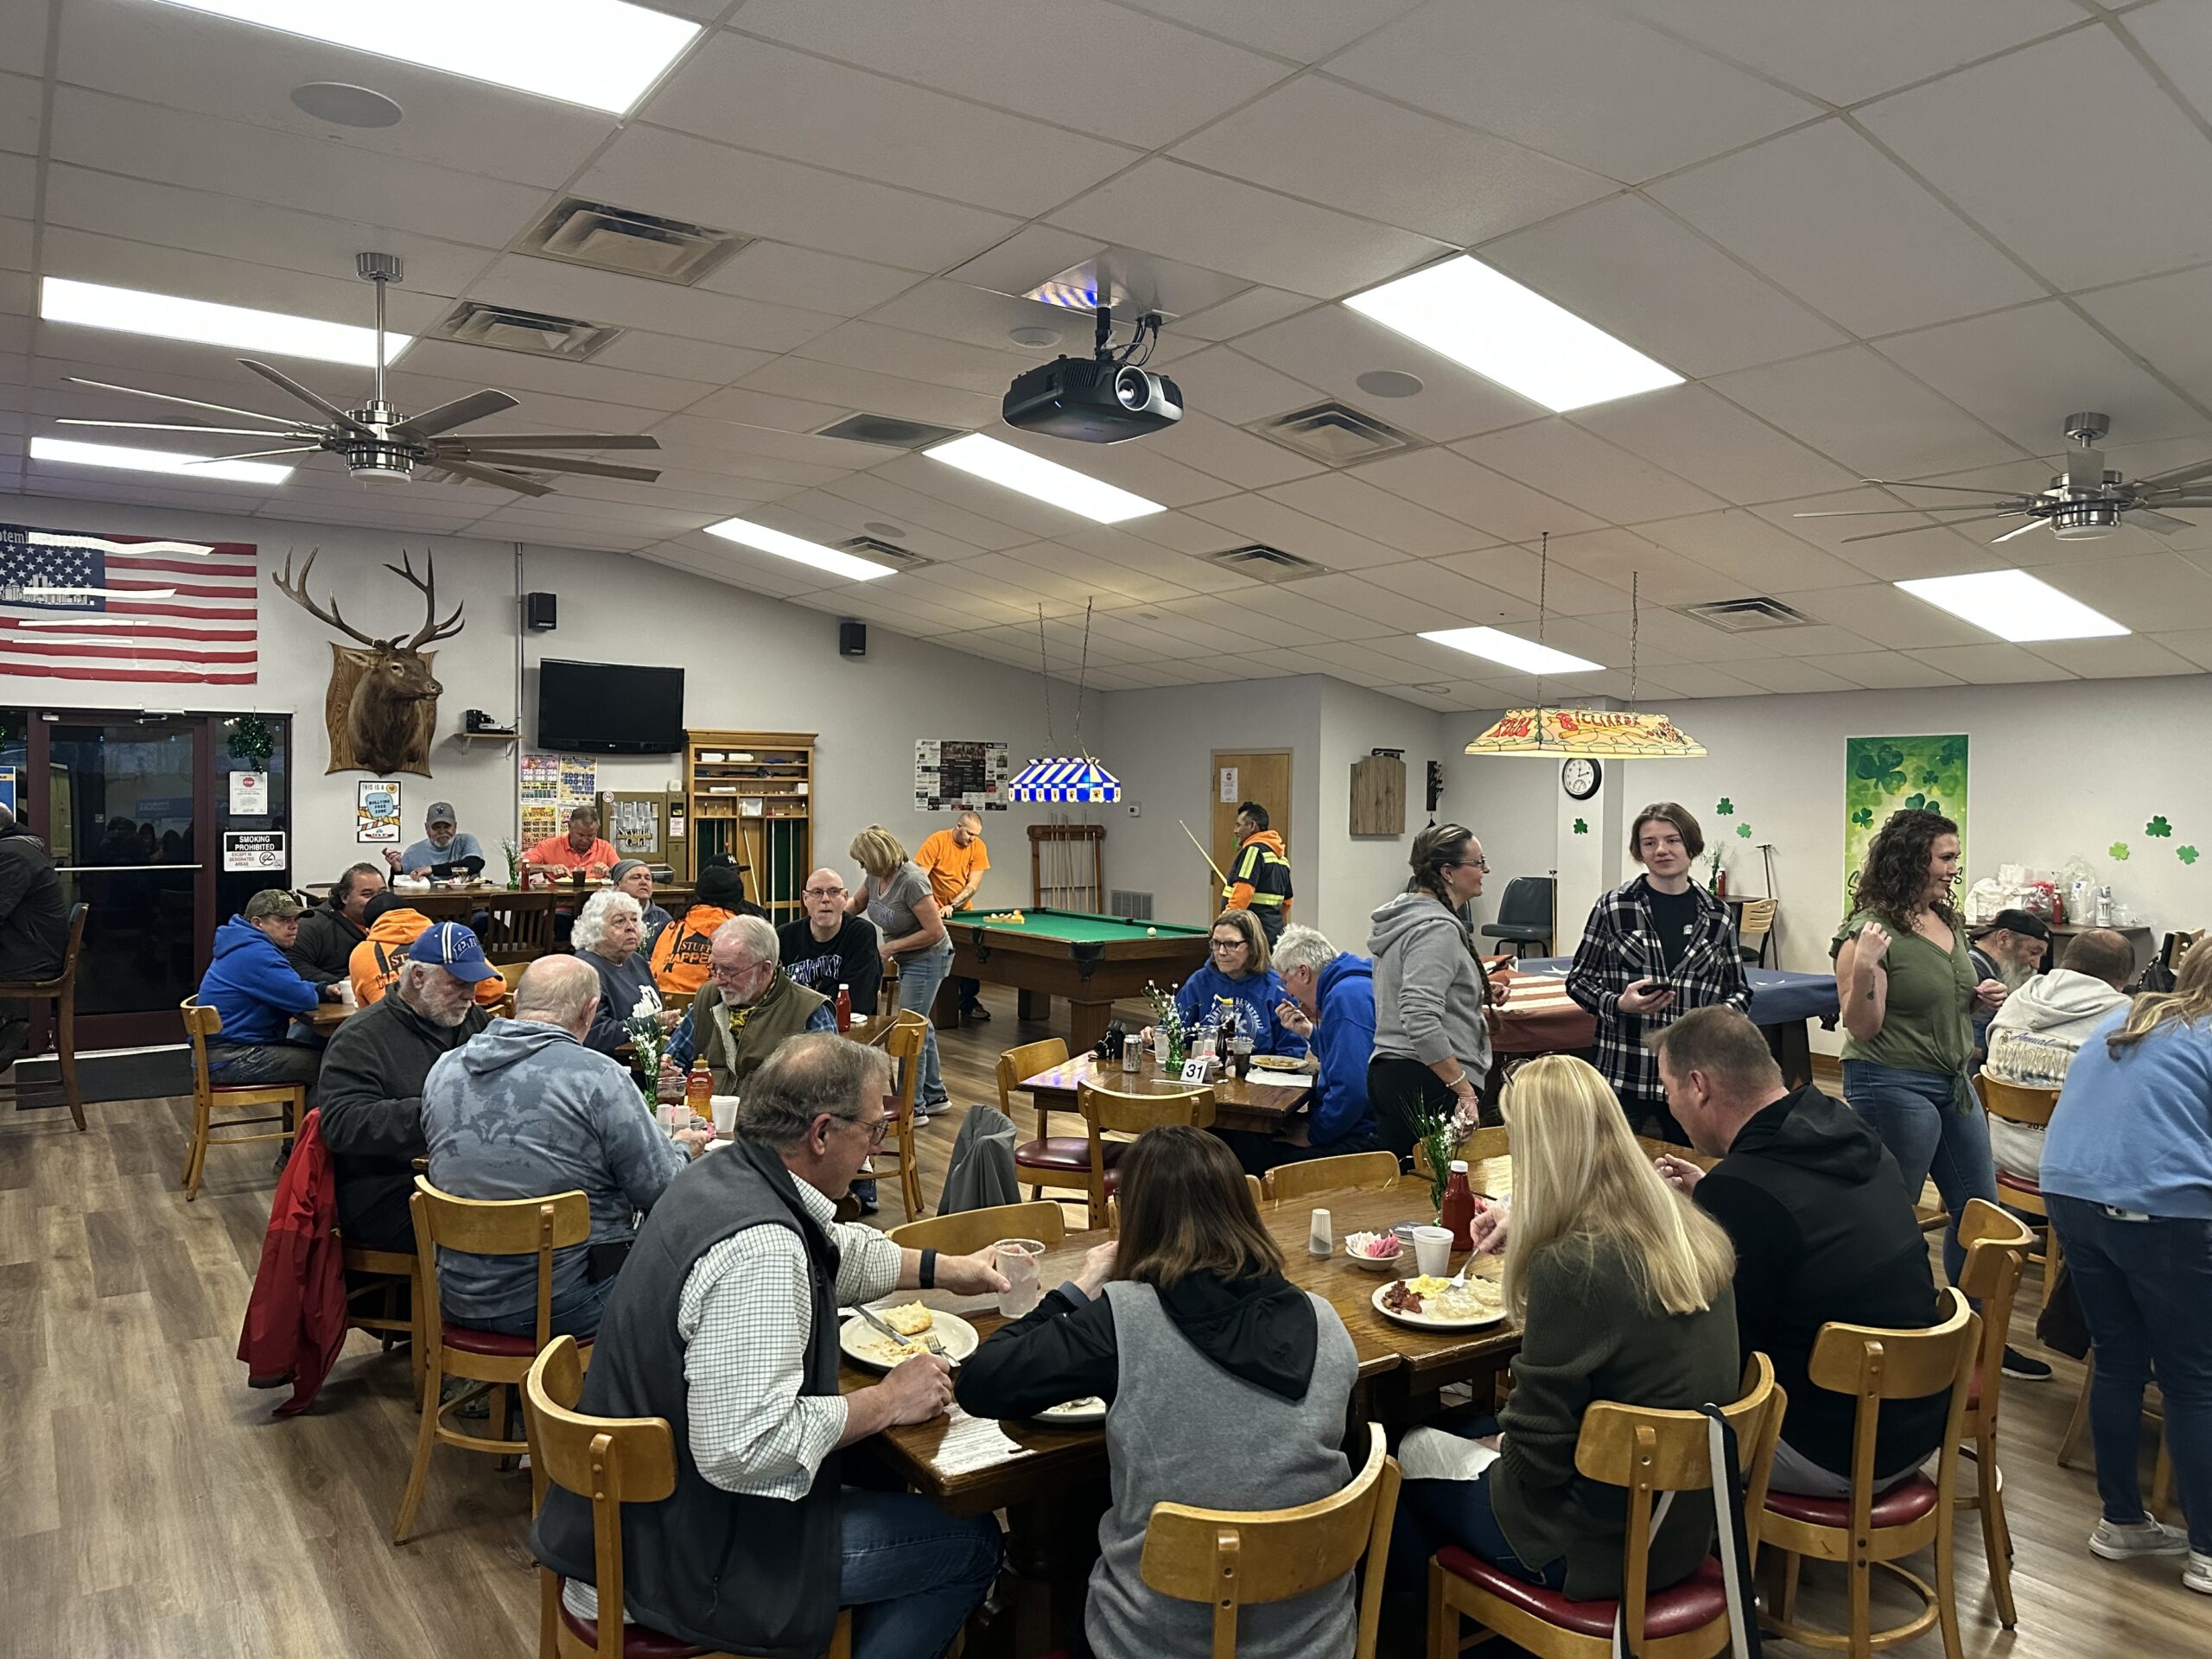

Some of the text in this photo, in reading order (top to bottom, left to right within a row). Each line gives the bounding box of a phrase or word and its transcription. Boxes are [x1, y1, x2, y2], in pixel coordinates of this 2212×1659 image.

[617, 827, 652, 836] Nevada
[2010, 1033, 2056, 1046] Annual
[1186, 1064, 1204, 1079] 31
